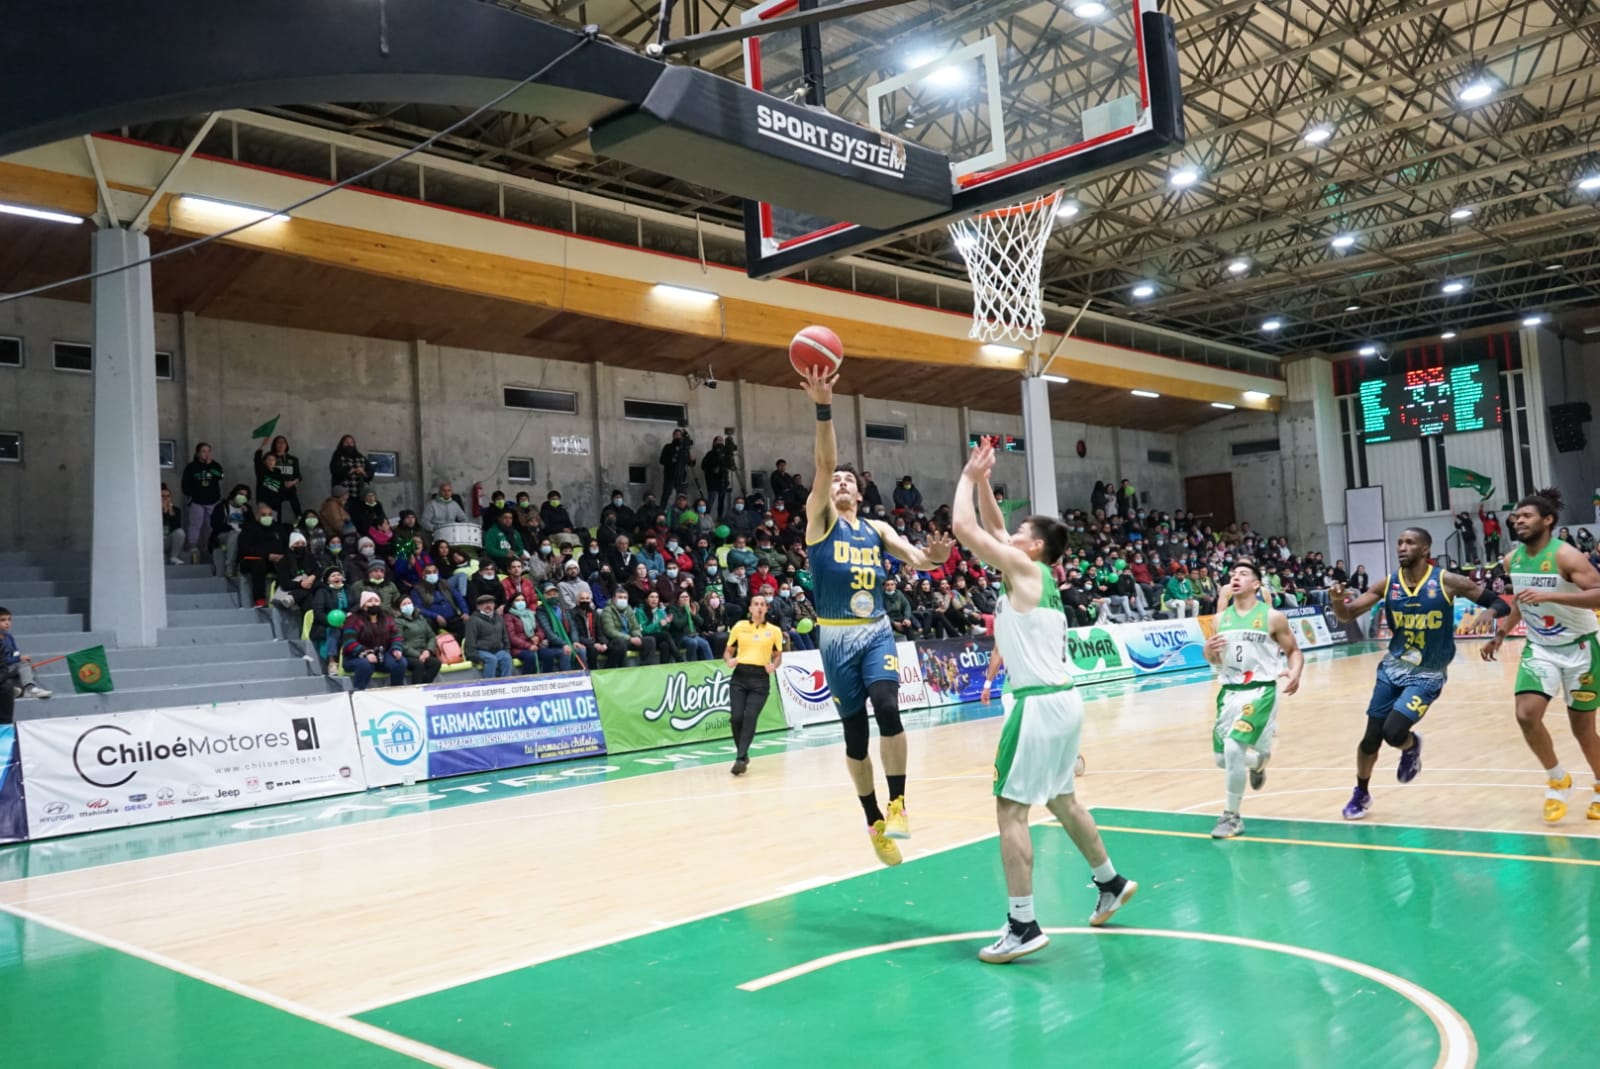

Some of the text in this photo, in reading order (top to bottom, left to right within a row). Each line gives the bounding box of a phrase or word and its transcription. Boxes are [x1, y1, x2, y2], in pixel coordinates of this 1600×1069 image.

[756, 105, 907, 171] SPORT SYSTEM
[850, 566, 876, 590] 30
[1404, 631, 1425, 649] 34
[1235, 645, 1243, 663] 2
[900, 665, 921, 684] LOA
[431, 695, 598, 735] FARMACÉUTICA CHILOE
[1406, 695, 1429, 717] 34
[215, 788, 240, 799] Jeep
